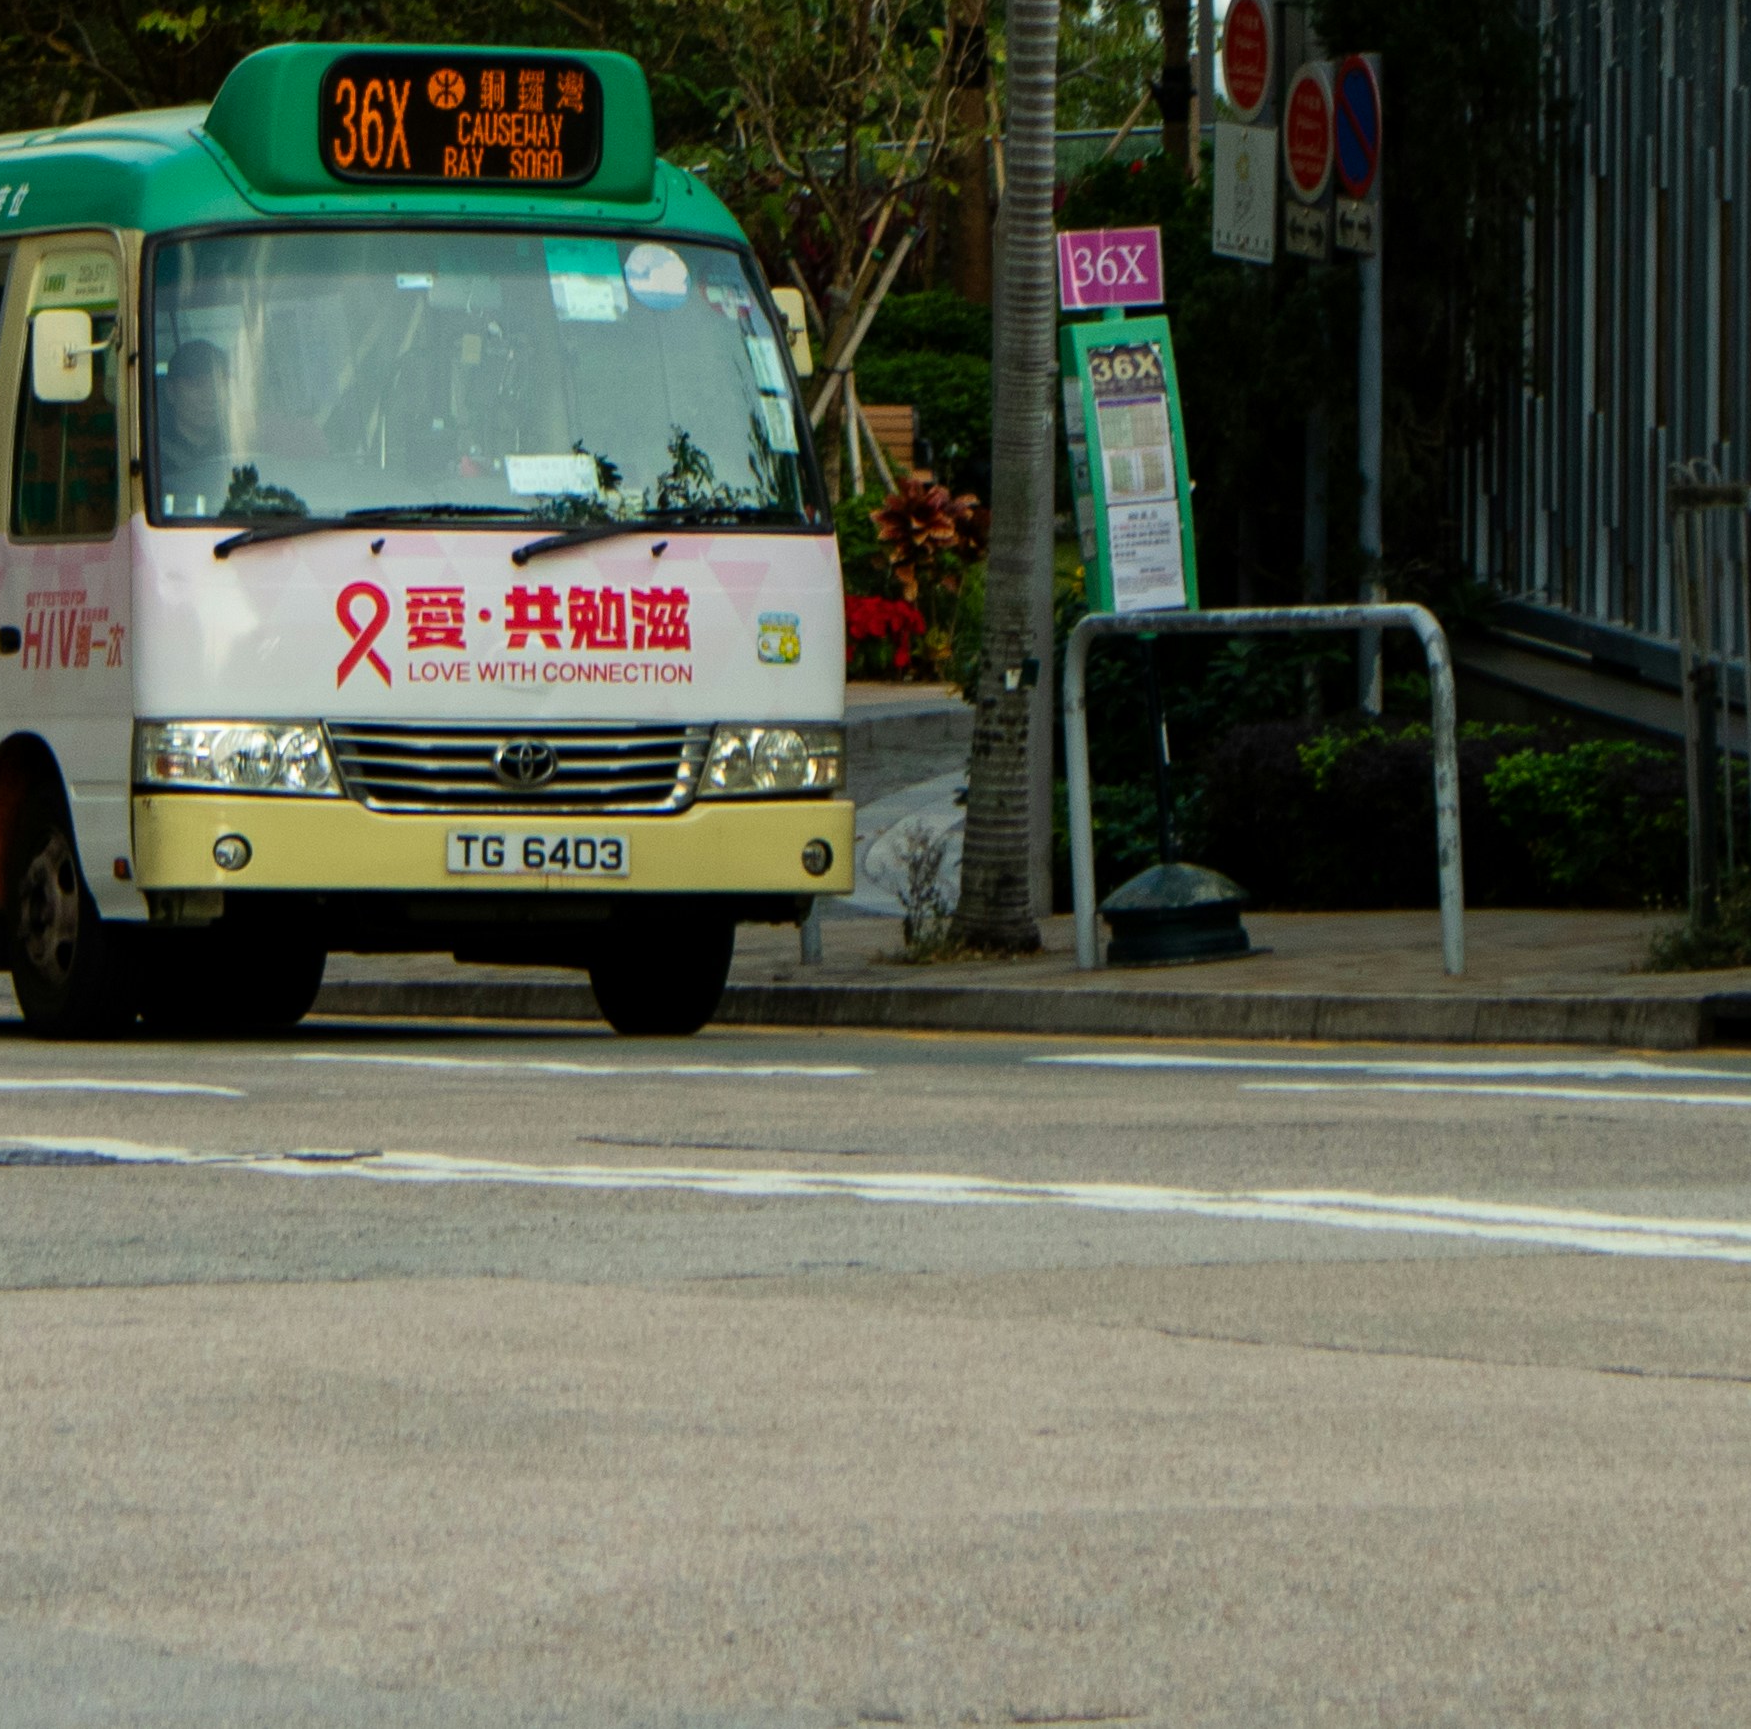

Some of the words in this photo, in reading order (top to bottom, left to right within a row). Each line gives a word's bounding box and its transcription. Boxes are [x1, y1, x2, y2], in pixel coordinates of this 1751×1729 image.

[480, 68, 585, 113] 銅鑼灣
[333, 76, 412, 169] 36X
[457, 112, 564, 147] CAUSEWAY
[443, 146, 485, 178] BAY
[510, 148, 563, 179] SOGO
[1073, 243, 1150, 288] 36X
[1091, 351, 1161, 384] 36X
[407, 660, 471, 684] LOVE
[477, 661, 537, 684] WITH
[542, 659, 694, 685] CONNECTION
[456, 835, 505, 866] TG
[522, 837, 623, 872] 6403
